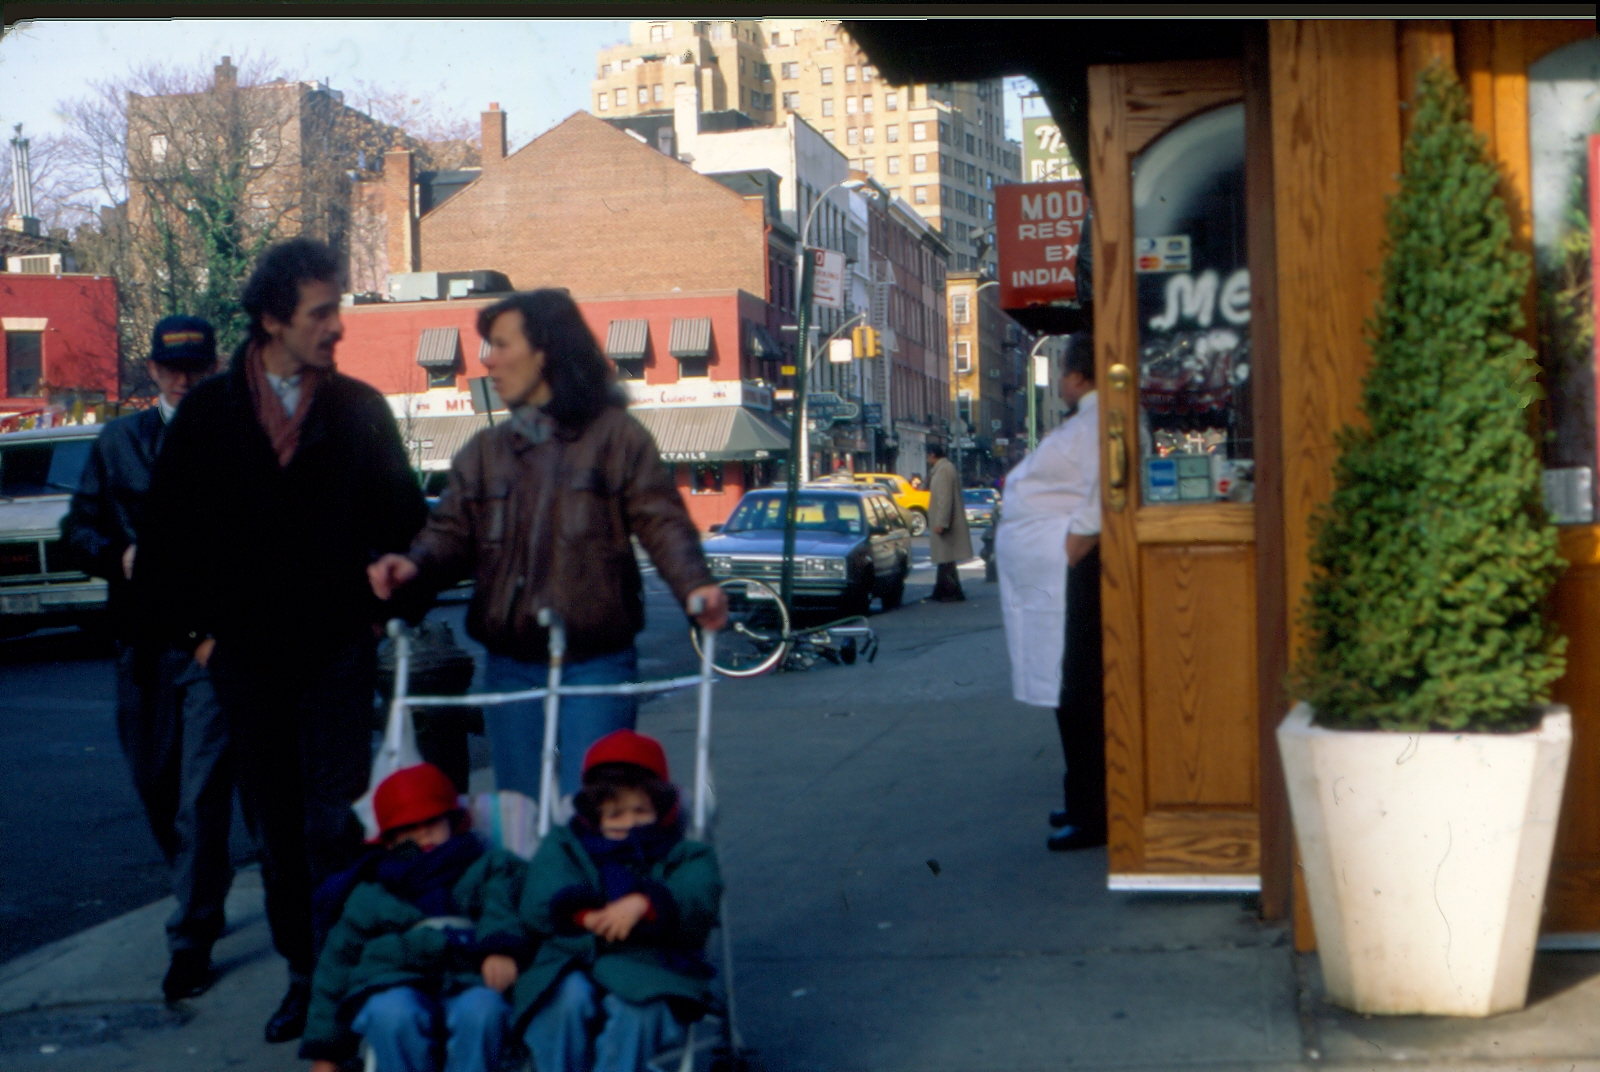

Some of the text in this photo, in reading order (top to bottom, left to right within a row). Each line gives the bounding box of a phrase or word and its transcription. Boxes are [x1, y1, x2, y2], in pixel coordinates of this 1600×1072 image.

[1021, 189, 1083, 221] MOD
[1044, 244, 1080, 262] EX
[1012, 267, 1076, 288] INDIA
